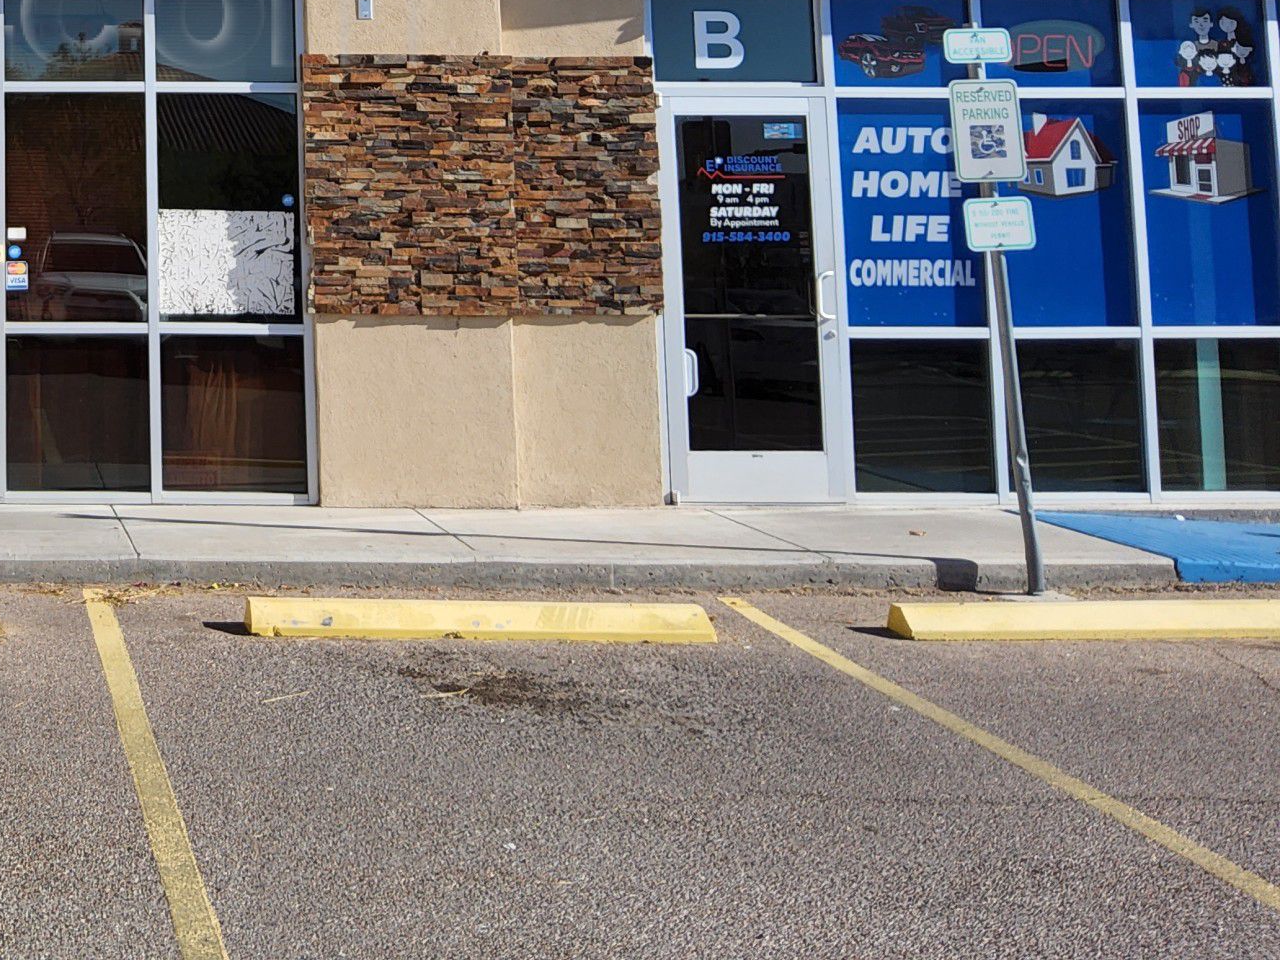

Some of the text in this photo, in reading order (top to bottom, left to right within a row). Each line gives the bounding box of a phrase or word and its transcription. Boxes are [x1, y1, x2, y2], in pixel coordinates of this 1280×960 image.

[693, 9, 745, 70] B
[1005, 33, 1094, 68] PEN
[955, 90, 1012, 103] RESERVED
[962, 107, 1009, 120] PARKING
[1177, 116, 1201, 141] SHOP
[851, 127, 955, 155] AUTO
[726, 155, 778, 164] DISCOUNT
[724, 163, 782, 172] INSURANCE
[711, 183, 742, 195] MON
[752, 183, 775, 194] FRI
[851, 170, 963, 198] HOME
[710, 206, 779, 218] SATURDAY
[710, 218, 780, 228] By Appointment
[870, 215, 951, 242] LIFE
[702, 231, 791, 242] 915-584-3400
[850, 259, 975, 287] COMMERCIAL
